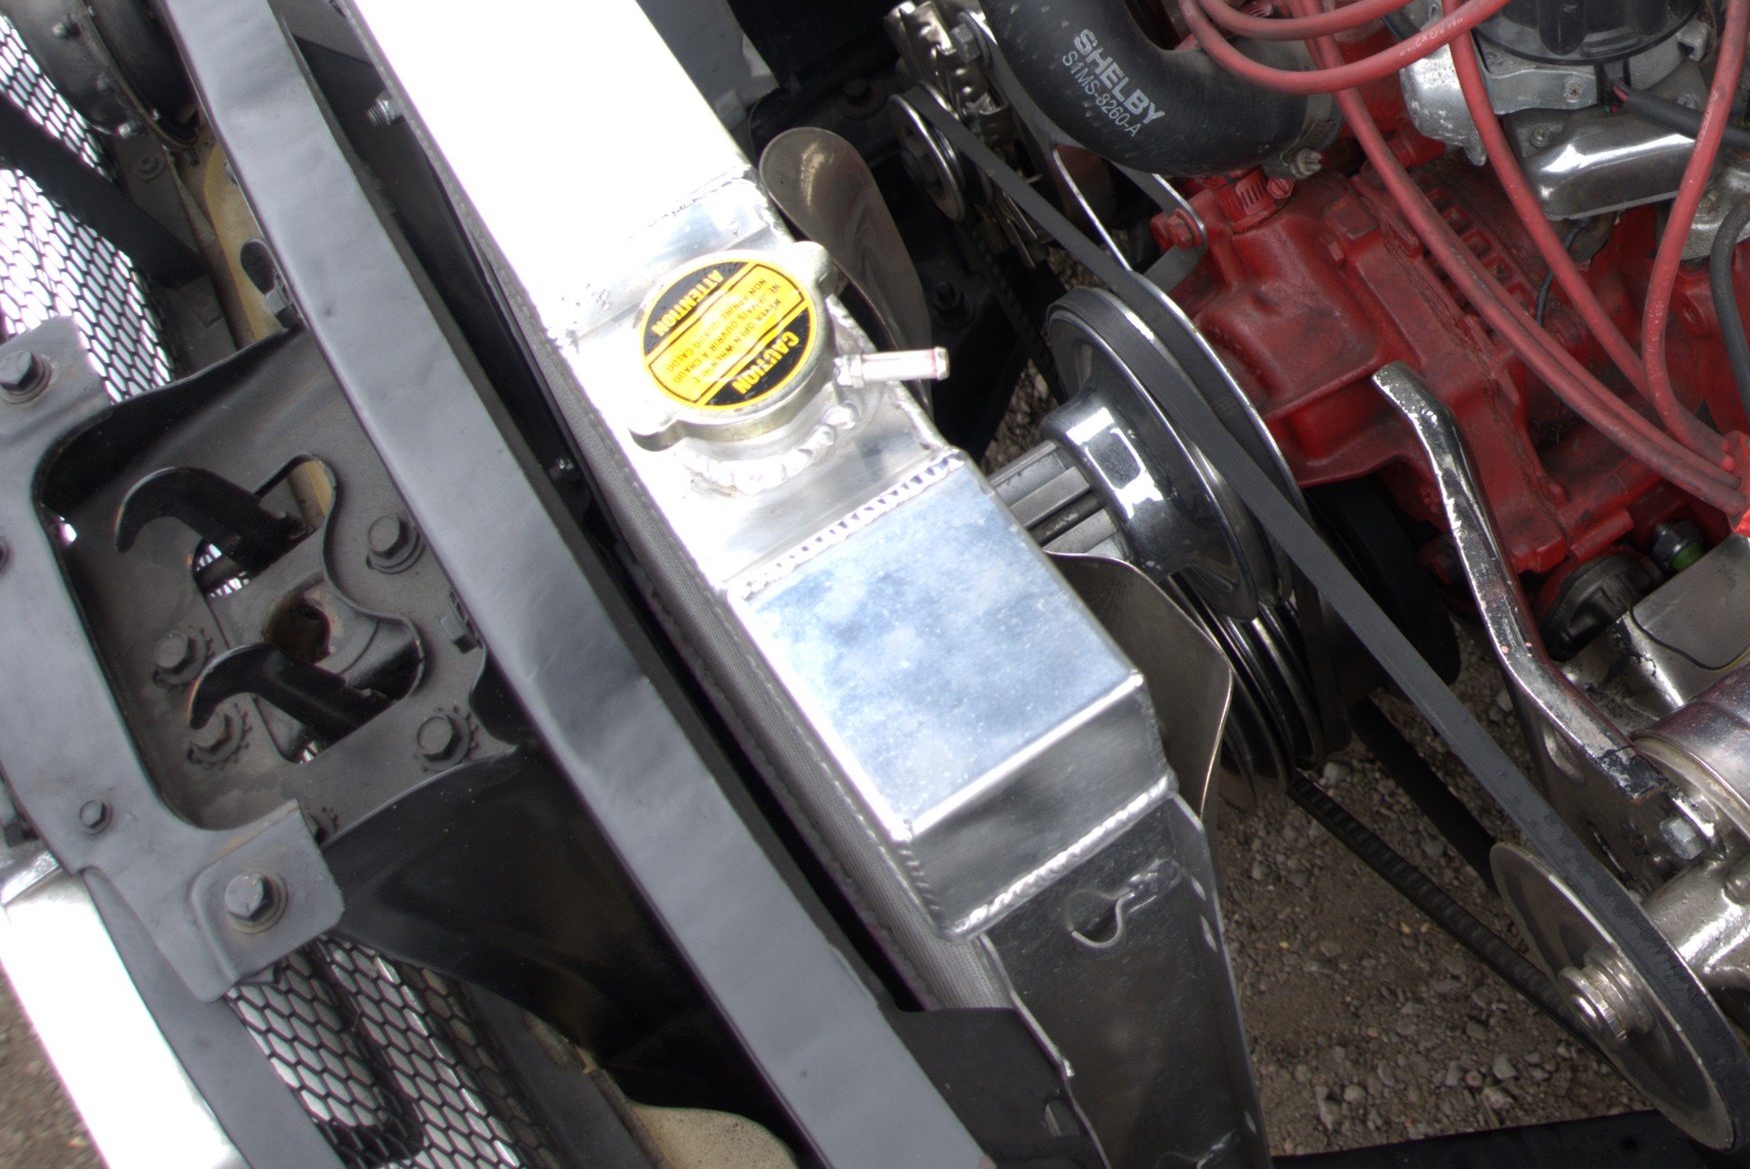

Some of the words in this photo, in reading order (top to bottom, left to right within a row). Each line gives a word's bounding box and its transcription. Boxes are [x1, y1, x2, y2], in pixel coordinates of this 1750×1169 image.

[1071, 31, 1166, 124] SHELBY
[1061, 51, 1141, 138] S1MS-8260-A
[747, 277, 767, 296] NON
[767, 281, 781, 295] NE
[651, 269, 724, 337] ATTENTION
[754, 297, 782, 323] NEVER
[708, 319, 739, 352] OUVRIR
[732, 320, 756, 344] OPEN
[664, 346, 694, 373] CALDO
[710, 342, 735, 368] WHEN
[732, 331, 800, 394] CAUTION
[672, 357, 702, 384] CHAUD
